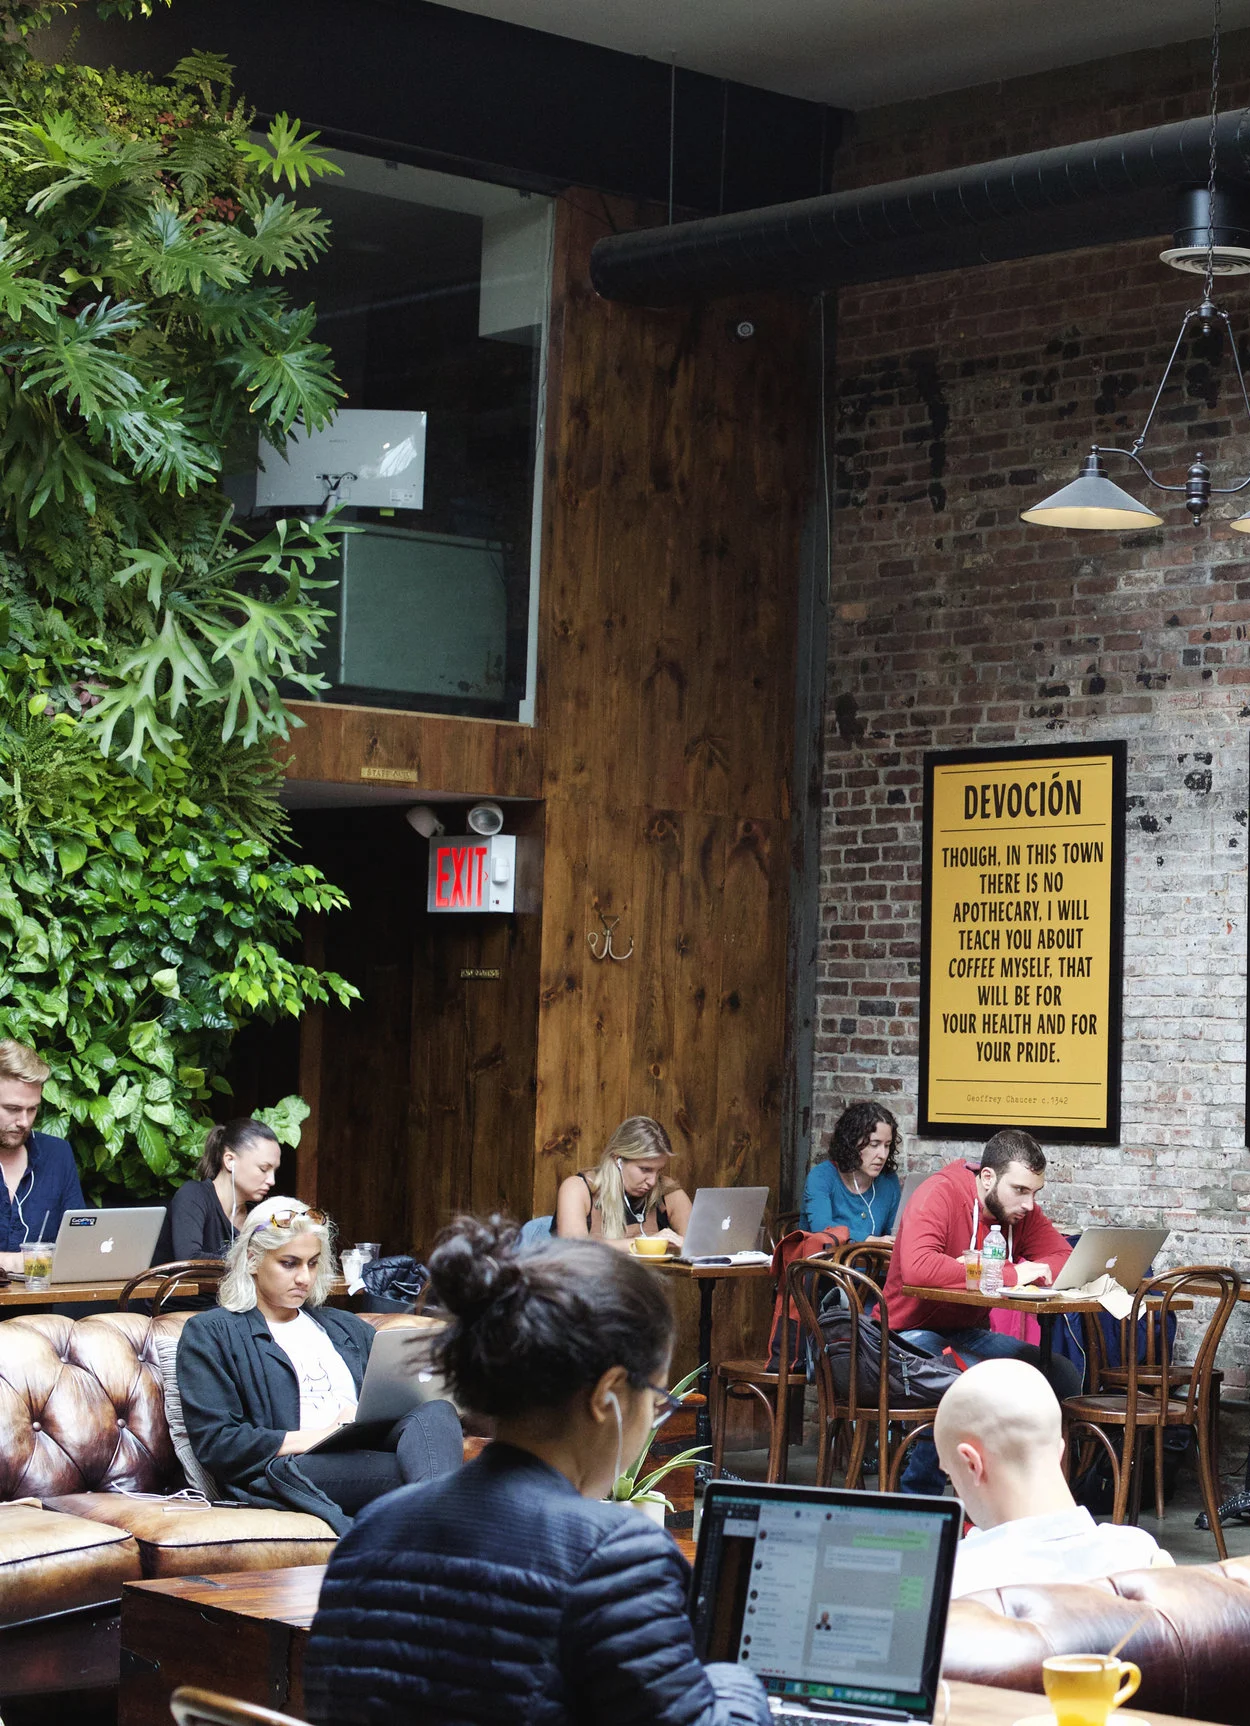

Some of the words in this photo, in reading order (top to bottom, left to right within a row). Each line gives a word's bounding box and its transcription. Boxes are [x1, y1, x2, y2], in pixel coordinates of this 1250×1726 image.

[963, 771, 1081, 820] DEVOCIÓN
[942, 846, 1000, 867] THOUGH,
[1007, 845, 1020, 865] IN
[1027, 844, 1056, 864] THIS
[1063, 842, 1103, 863] TOWN
[435, 847, 487, 907] EXIT
[980, 873, 1020, 894] THERE
[1027, 873, 1037, 893] IS
[1044, 872, 1063, 892] NO
[953, 901, 1041, 922] APOTHECARY,
[1048, 901, 1051, 920] I
[1058, 900, 1089, 920] WILL
[959, 930, 999, 950] TEACH
[1006, 929, 1031, 949] YOU
[1038, 928, 1083, 949] ABOUT
[949, 958, 995, 978] COFFEE
[1001, 957, 1052, 978] MYSELF,
[1058, 957, 1092, 977] THAT
[978, 986, 1008, 1005] WILL
[1015, 986, 1030, 1006] BE
[1037, 986, 1061, 1006] FOR
[943, 1014, 976, 1033] YOUR
[983, 1014, 1031, 1034] HEALTH
[1037, 1014, 1065, 1034] AND
[1072, 1014, 1097, 1035] FOR
[977, 1042, 1011, 1062] YOUR
[1017, 1042, 1060, 1062] PRIDE.
[966, 1094, 1002, 1105] Geoffrey
[1005, 1095, 1038, 1104] Chaucer
